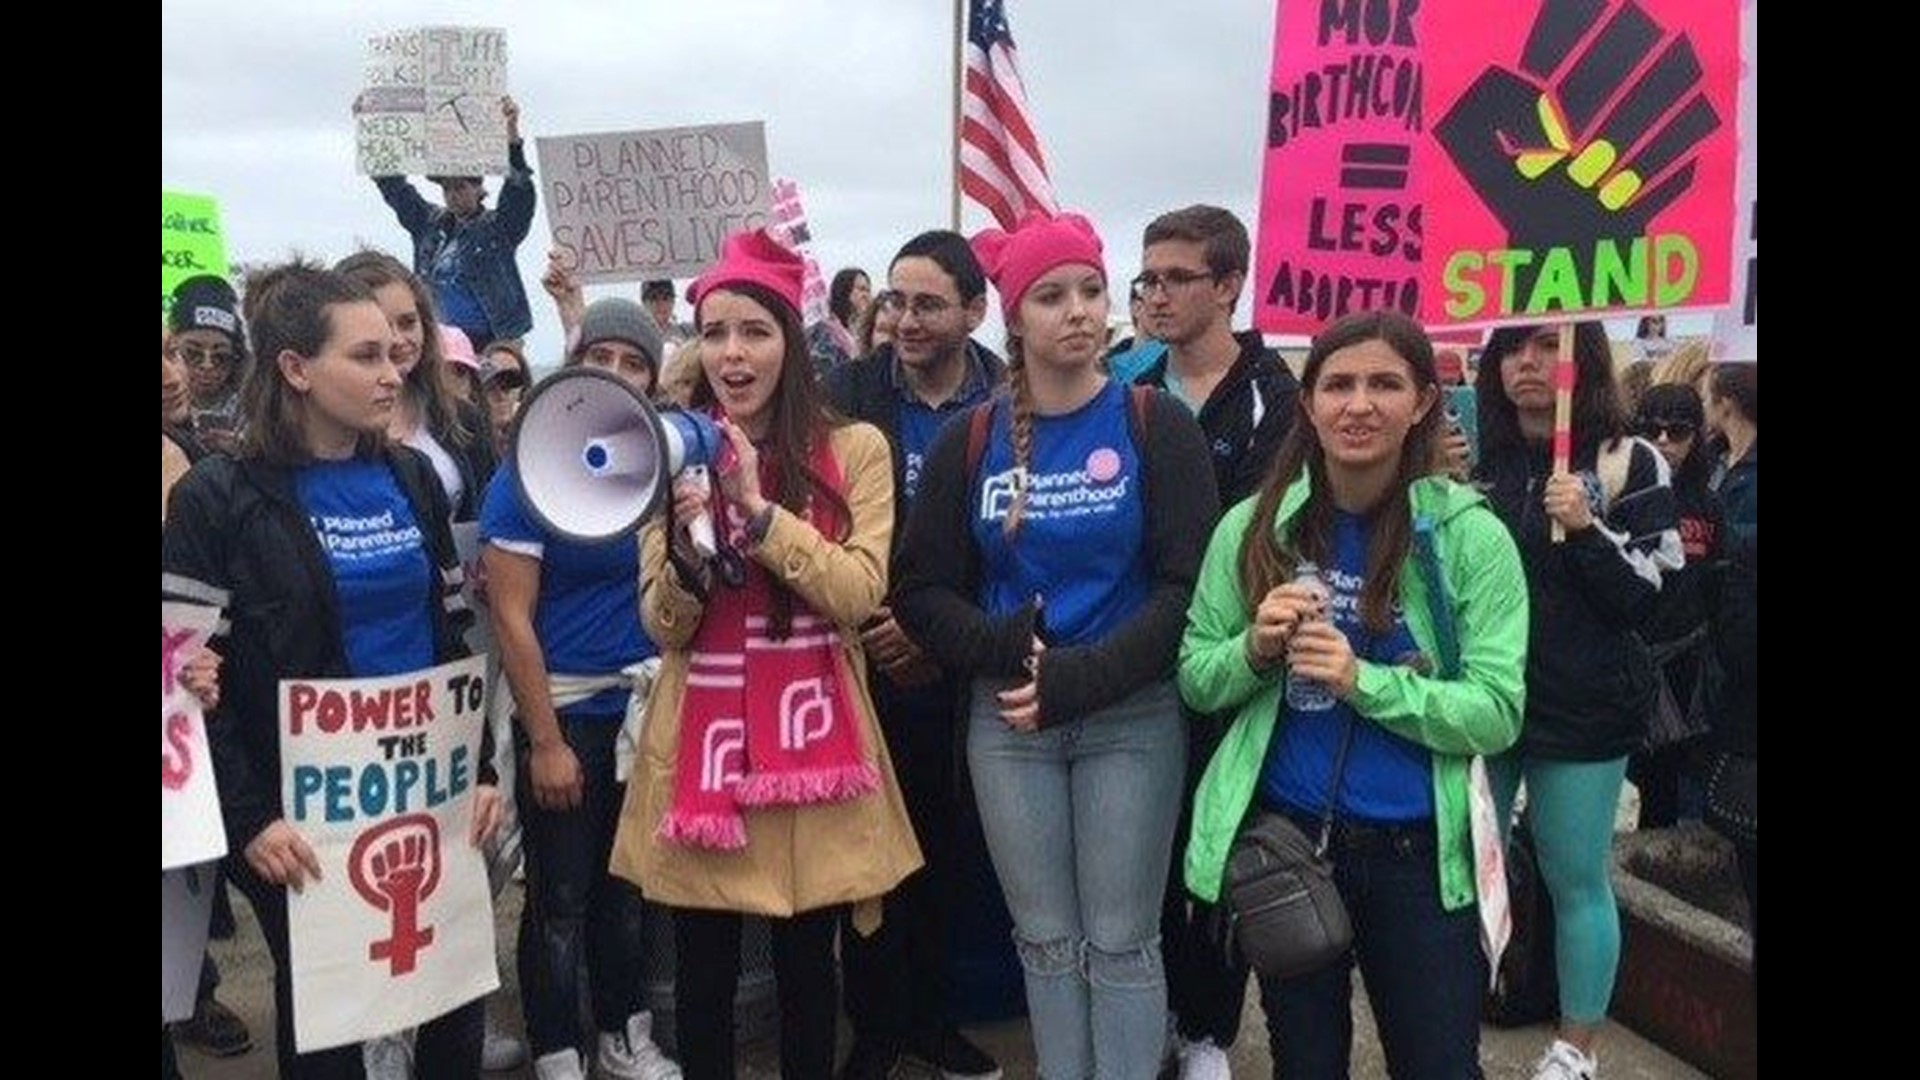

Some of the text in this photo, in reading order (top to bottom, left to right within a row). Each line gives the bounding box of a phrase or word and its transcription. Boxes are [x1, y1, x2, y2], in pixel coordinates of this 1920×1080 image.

[573, 133, 719, 177] PLANNED
[553, 169, 759, 217] PARENTHOOD
[1442, 233, 1698, 320] STAND
[326, 526, 421, 550] Parenthoo
[289, 673, 484, 735] POWER TO
[377, 732, 428, 761] THE
[293, 743, 469, 823] PEOPLE
